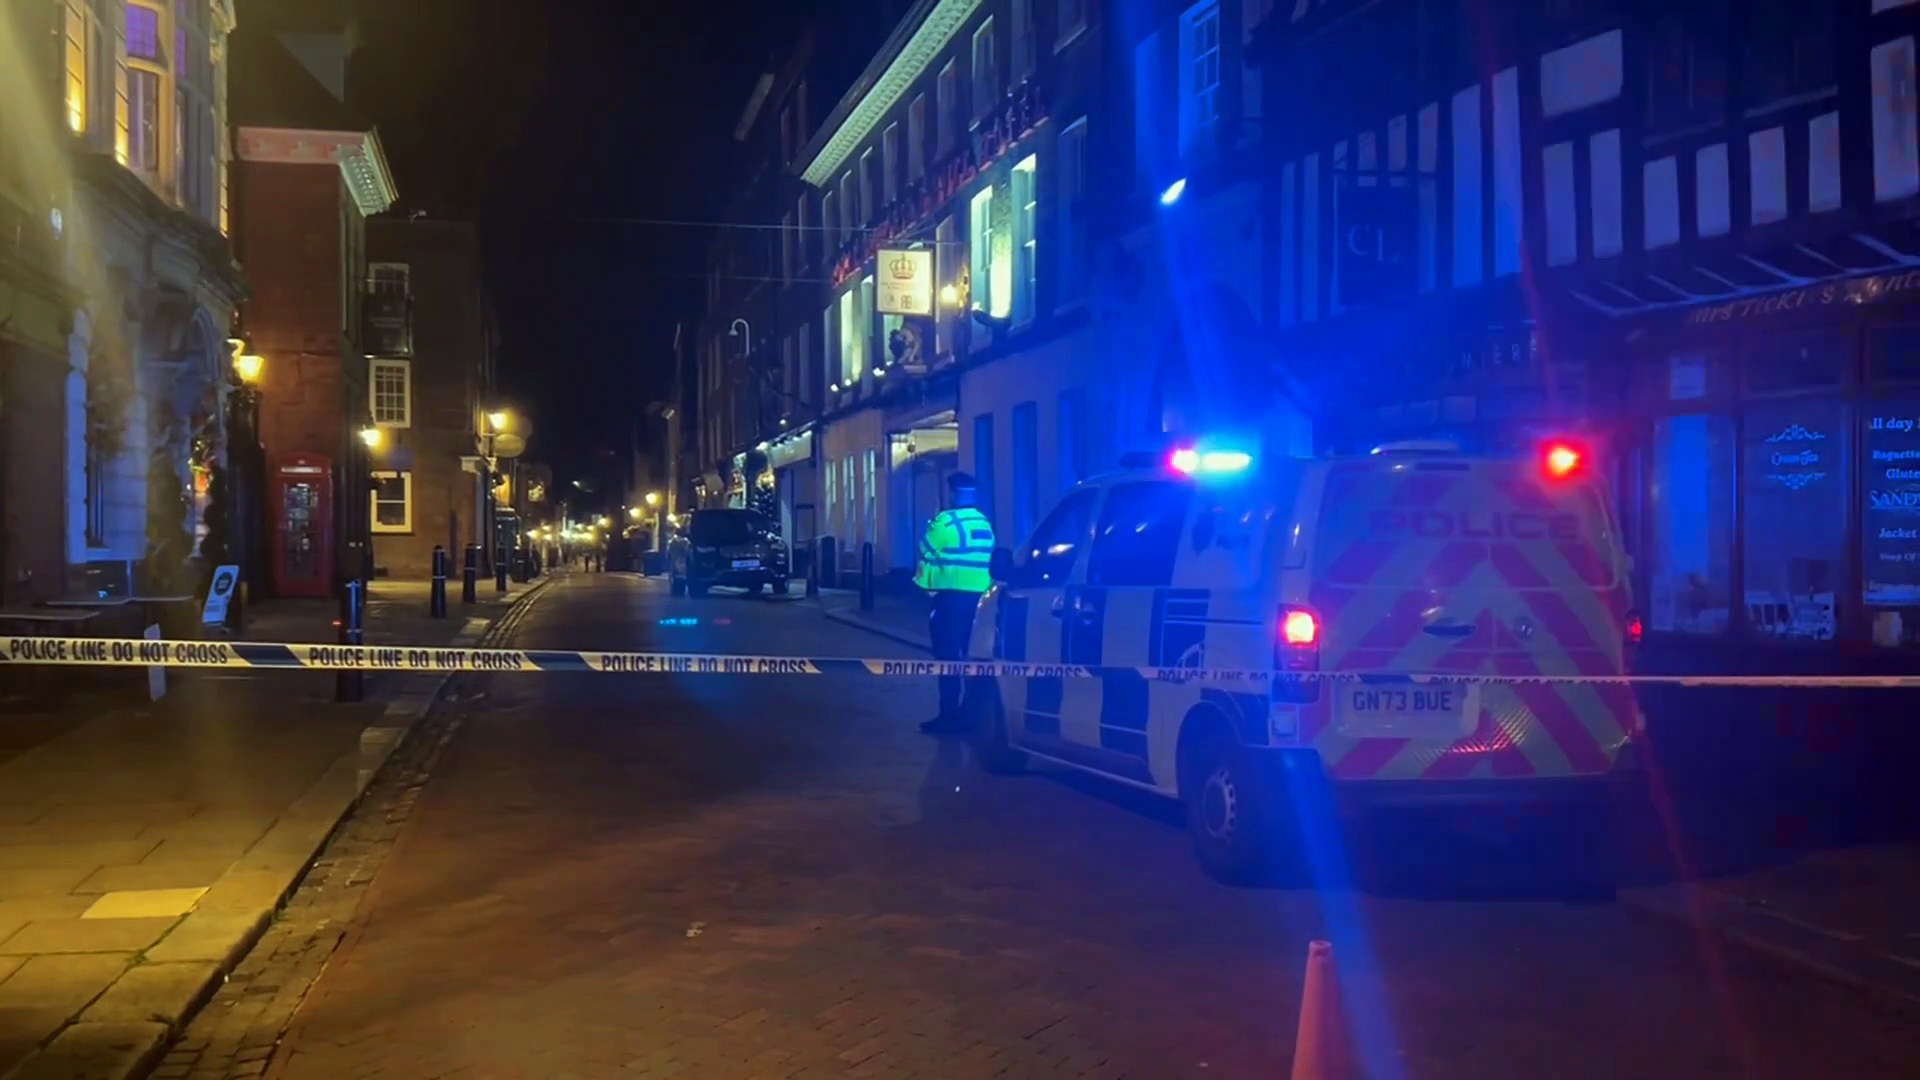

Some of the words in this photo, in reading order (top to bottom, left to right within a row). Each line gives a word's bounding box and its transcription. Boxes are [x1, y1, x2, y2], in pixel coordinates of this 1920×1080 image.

[1886, 417, 1914, 432] day
[1870, 489, 1920, 510] SAND
[1368, 511, 1578, 540] POLICE
[1878, 527, 1917, 539] Jacket
[10, 638, 66, 661] POLICE
[72, 640, 107, 662] LINE
[112, 641, 133, 662] DO
[139, 642, 170, 663] NOT
[175, 643, 228, 664] CROSS
[309, 647, 364, 667] POLICE
[370, 648, 403, 668] LINE
[408, 650, 429, 668] DO
[436, 651, 466, 669] NOT
[471, 652, 521, 670] CROSS
[601, 655, 655, 672] POLICE
[660, 656, 692, 672] LINE
[698, 657, 717, 672] DO
[724, 658, 753, 673] NOT
[758, 658, 807, 674] CROSS
[883, 662, 935, 675] POLICE
[940, 664, 970, 676] LINE
[1353, 691, 1407, 711] GN73
[1413, 691, 1453, 711] BUE
